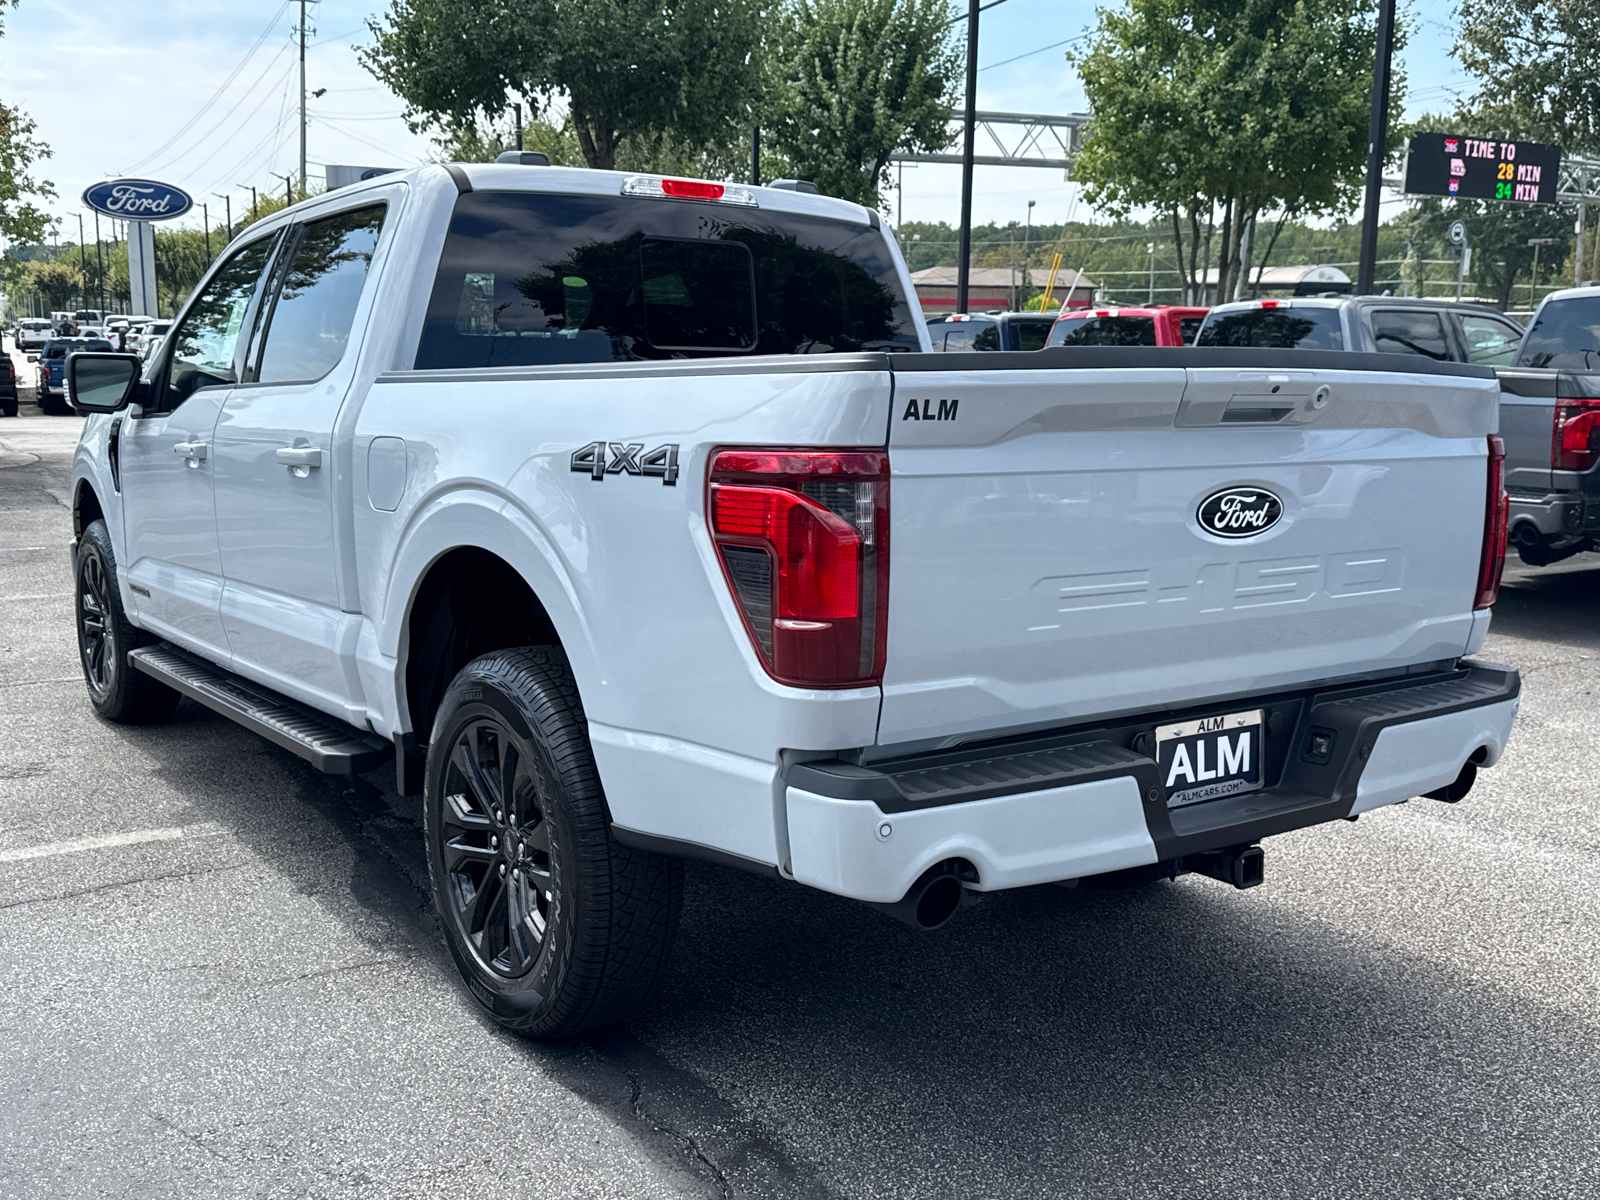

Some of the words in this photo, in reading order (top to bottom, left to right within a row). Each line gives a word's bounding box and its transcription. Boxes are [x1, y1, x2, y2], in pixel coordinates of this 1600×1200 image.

[1464, 139, 1496, 159] TIME
[1500, 143, 1515, 160] TO
[1497, 162, 1514, 180] 28
[1517, 164, 1541, 182] MIN
[106, 185, 171, 212] Ford
[1495, 182, 1512, 199] 34
[1515, 184, 1539, 202] MIN
[902, 398, 959, 421] ALM
[1213, 494, 1269, 529] Ford
[736, 562, 770, 571] FORD
[1027, 547, 1404, 631] F-150
[1197, 716, 1225, 734] ALM
[1165, 731, 1251, 788] ALM
[1181, 782, 1240, 802] ALMCARS.COM
